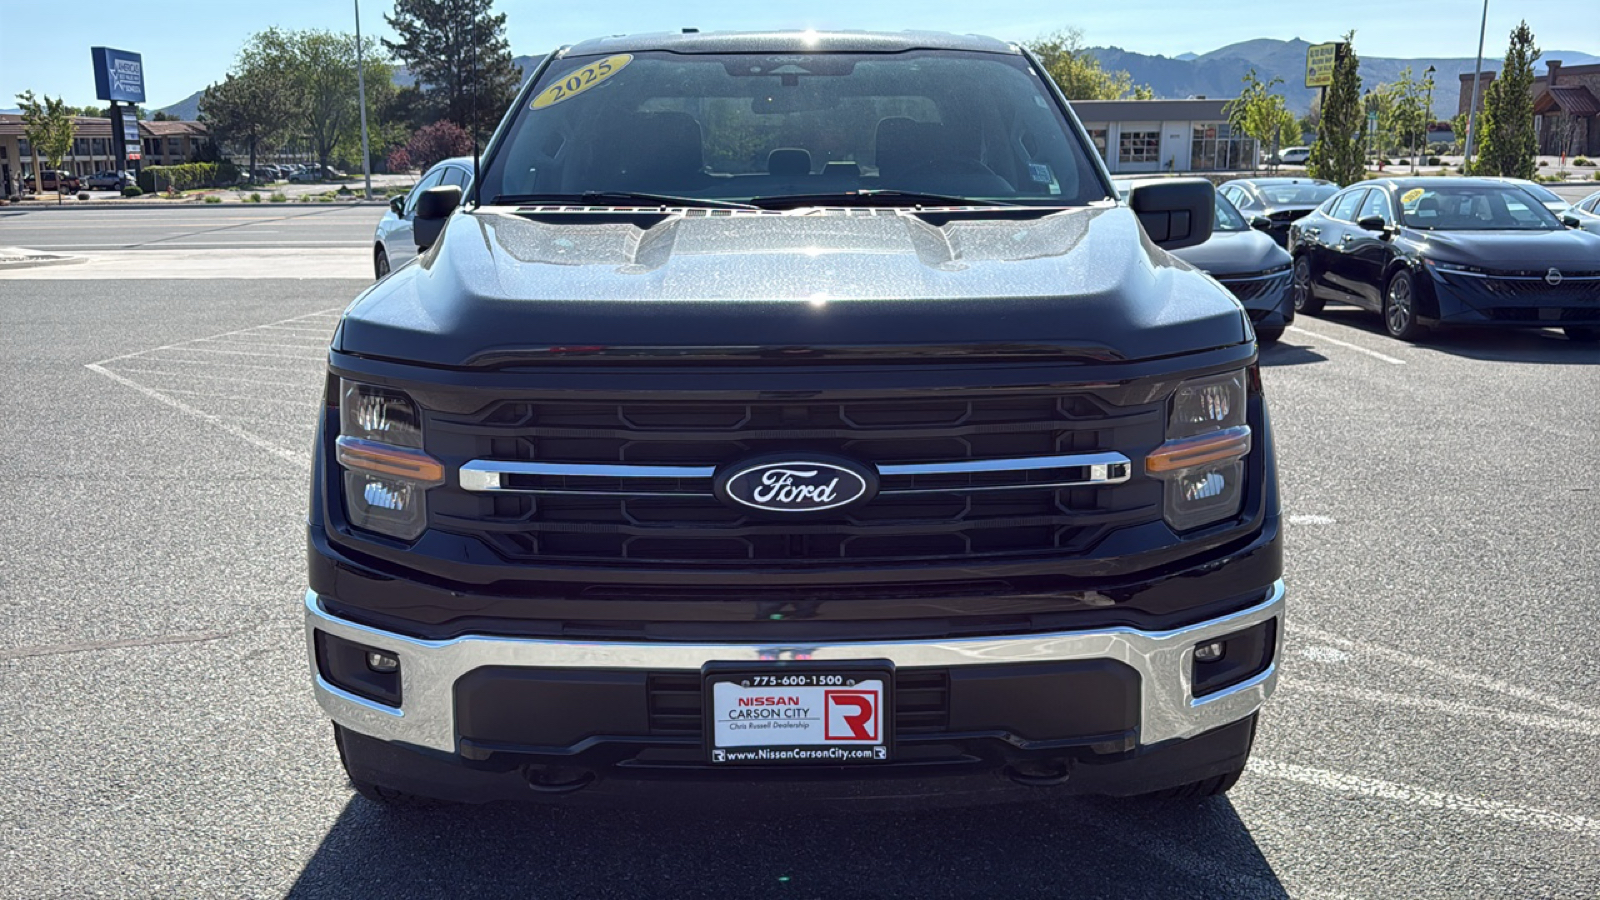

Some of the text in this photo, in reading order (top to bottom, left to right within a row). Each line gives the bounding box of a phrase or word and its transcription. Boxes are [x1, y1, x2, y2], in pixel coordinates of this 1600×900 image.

[549, 59, 612, 102] 2025
[753, 469, 839, 503] Ford
[753, 675, 843, 686] 775-600-1500
[738, 696, 800, 707] NISSAN
[728, 707, 810, 720] CARSON CITY
[729, 720, 810, 730] Chris Russell Dealership
[727, 747, 872, 760] www.NissanCarsonCity.com
